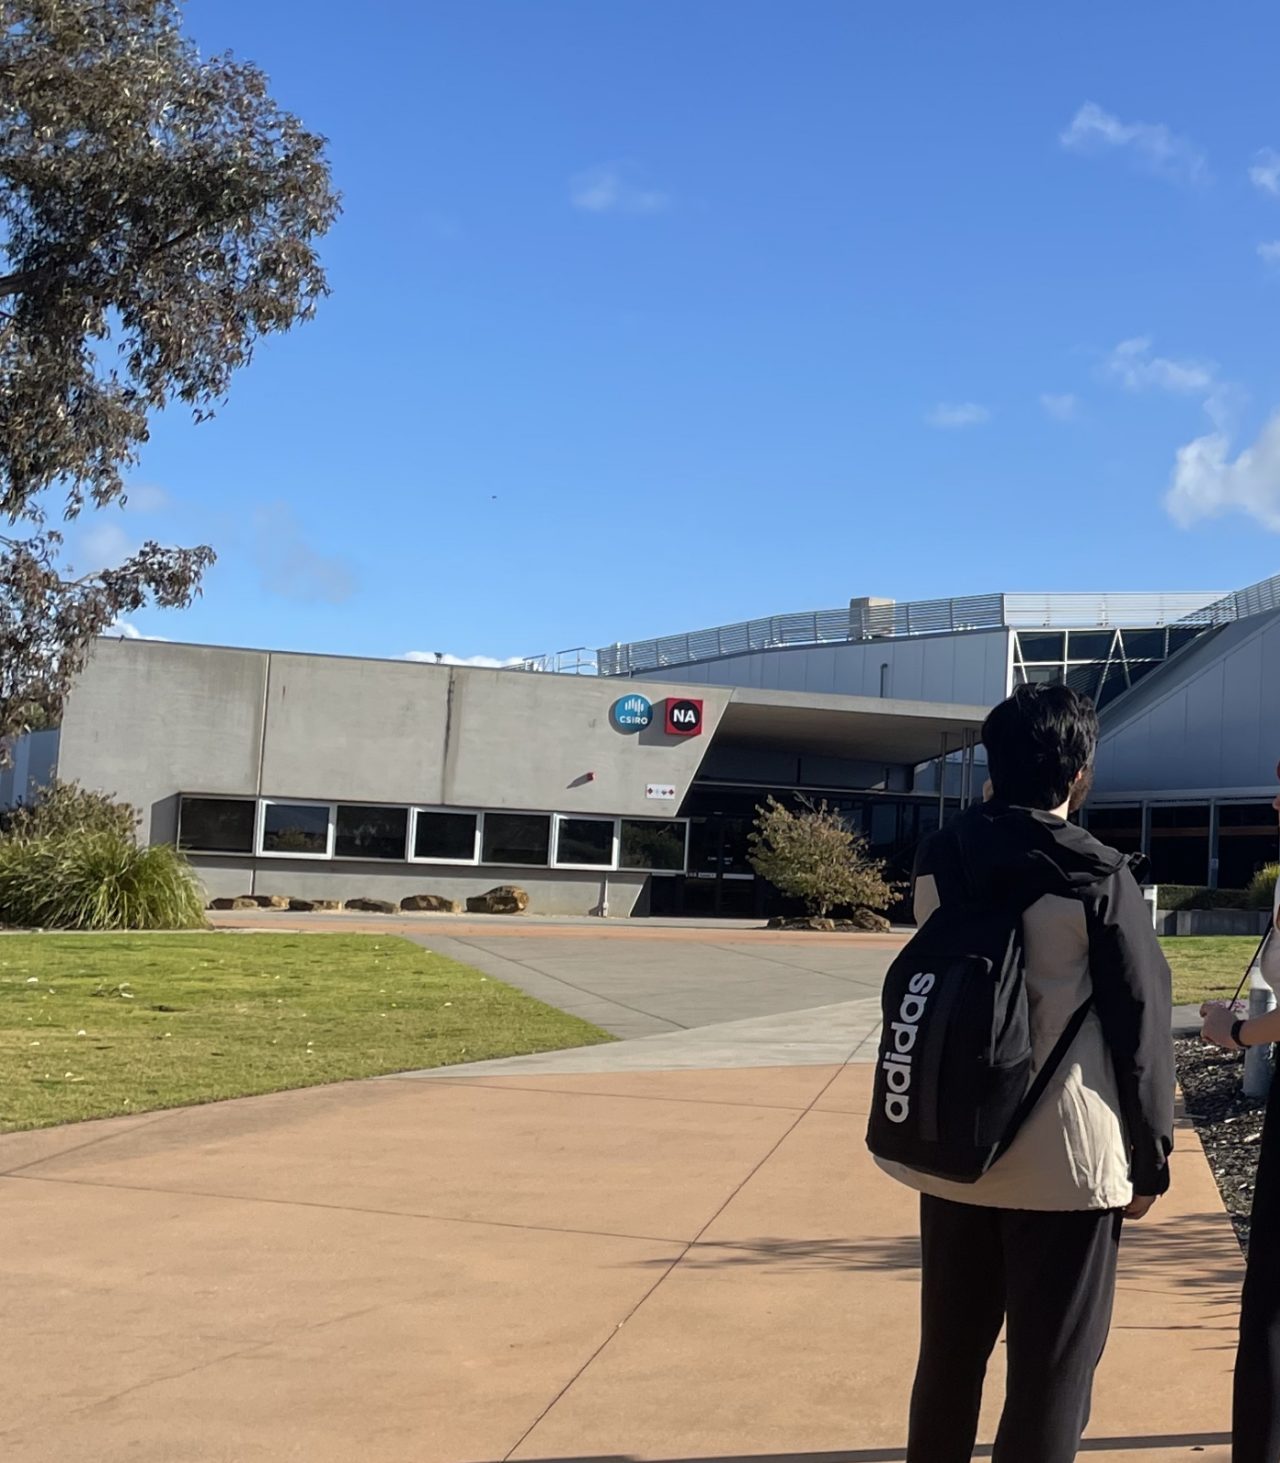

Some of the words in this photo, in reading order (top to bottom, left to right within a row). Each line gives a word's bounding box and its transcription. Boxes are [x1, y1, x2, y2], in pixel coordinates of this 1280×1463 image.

[620, 716, 648, 725] CSIRO
[673, 709, 696, 724] NA
[882, 972, 936, 1123] adidas
